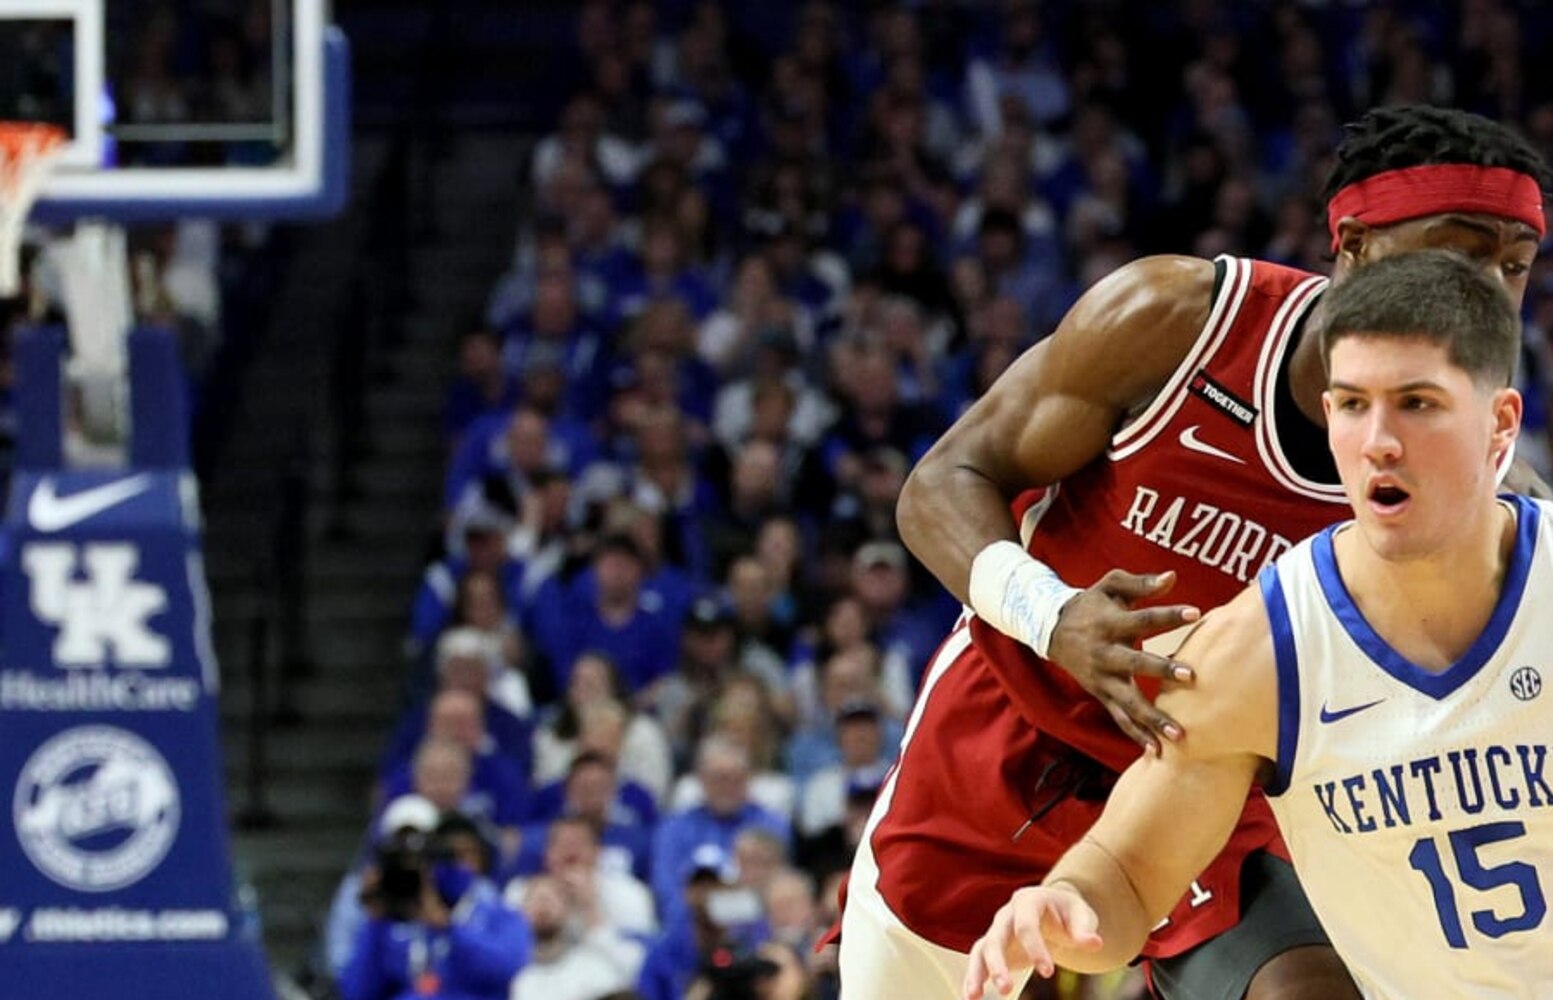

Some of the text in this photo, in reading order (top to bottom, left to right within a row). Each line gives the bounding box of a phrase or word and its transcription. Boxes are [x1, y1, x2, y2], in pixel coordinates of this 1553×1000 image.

[1203, 382, 1254, 424] TOGETHER
[21, 541, 173, 669] UK
[1510, 667, 1542, 701] SEC
[1408, 821, 1547, 949] 15
